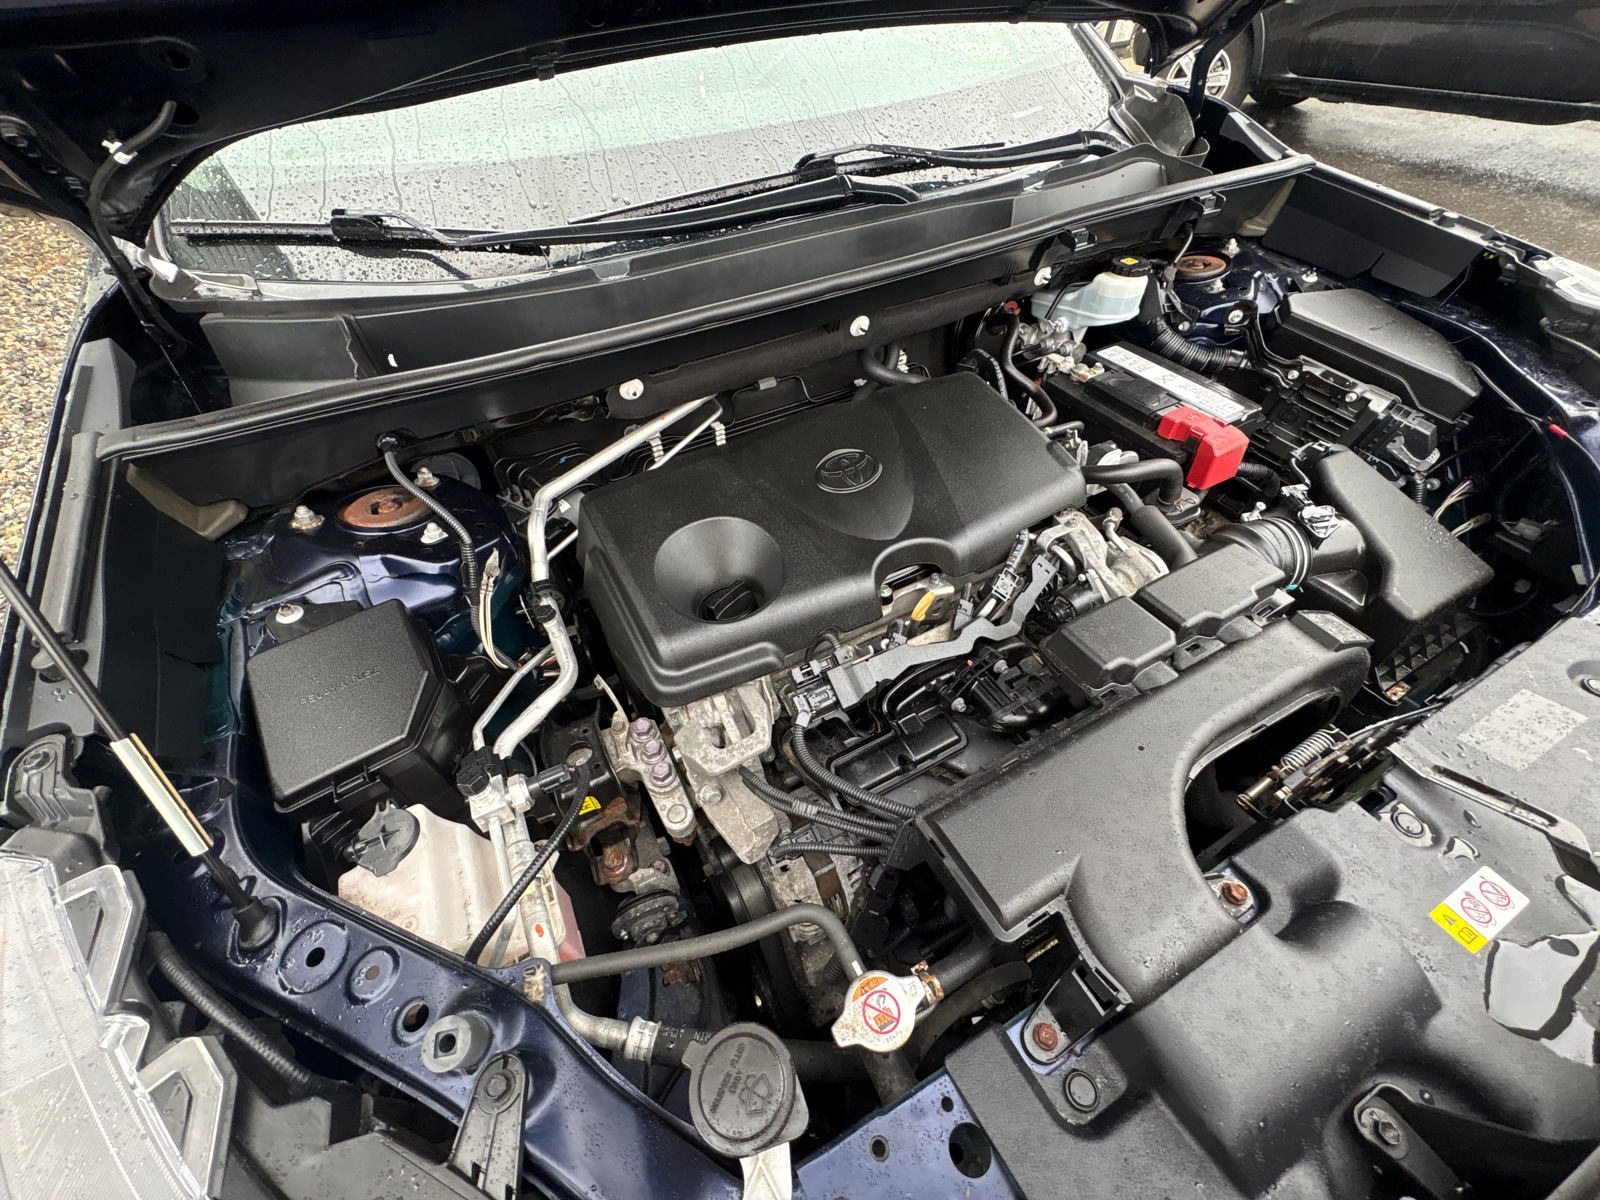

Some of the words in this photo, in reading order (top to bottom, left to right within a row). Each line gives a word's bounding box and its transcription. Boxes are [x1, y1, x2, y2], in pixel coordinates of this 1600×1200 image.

[300, 685, 337, 706] RELAY
[352, 665, 380, 684] FUSE
[730, 1042, 746, 1069] FLUID
